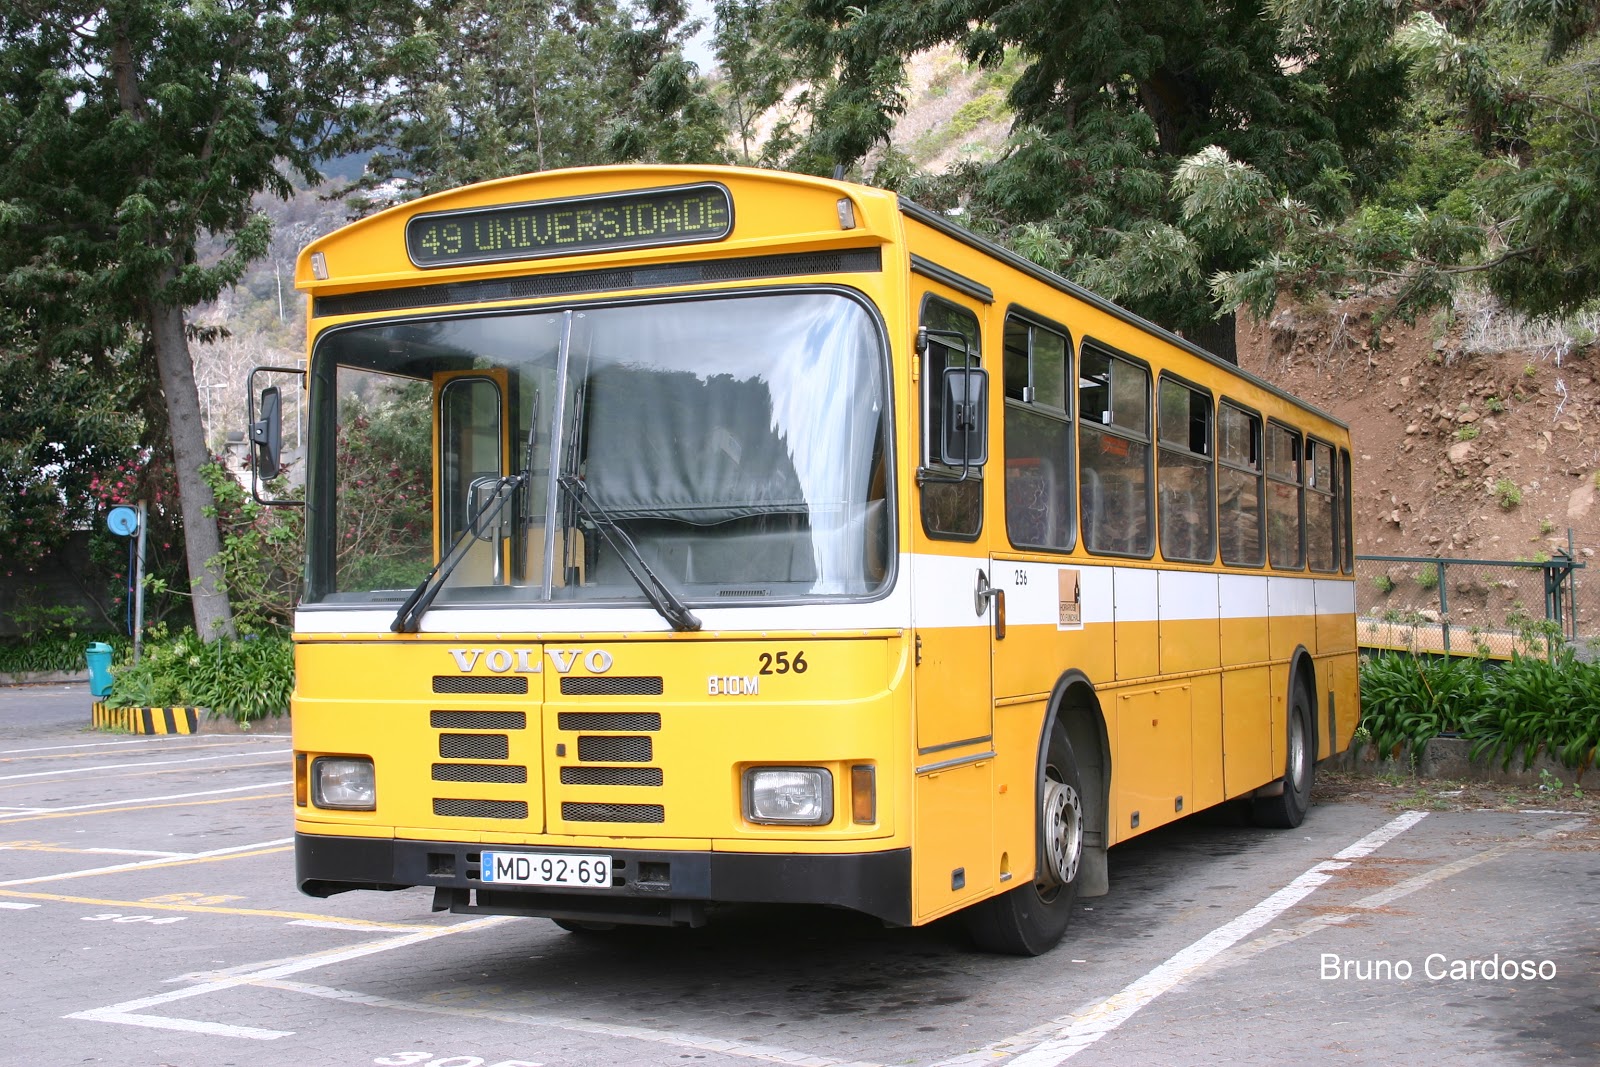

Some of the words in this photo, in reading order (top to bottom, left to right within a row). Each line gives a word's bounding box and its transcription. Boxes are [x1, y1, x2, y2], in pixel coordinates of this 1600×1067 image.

[421, 224, 462, 255] 49
[474, 197, 728, 251] UNIVERSIDADE
[1015, 570, 1027, 585] 256
[448, 649, 613, 674] VOLVO
[758, 651, 808, 676] 256
